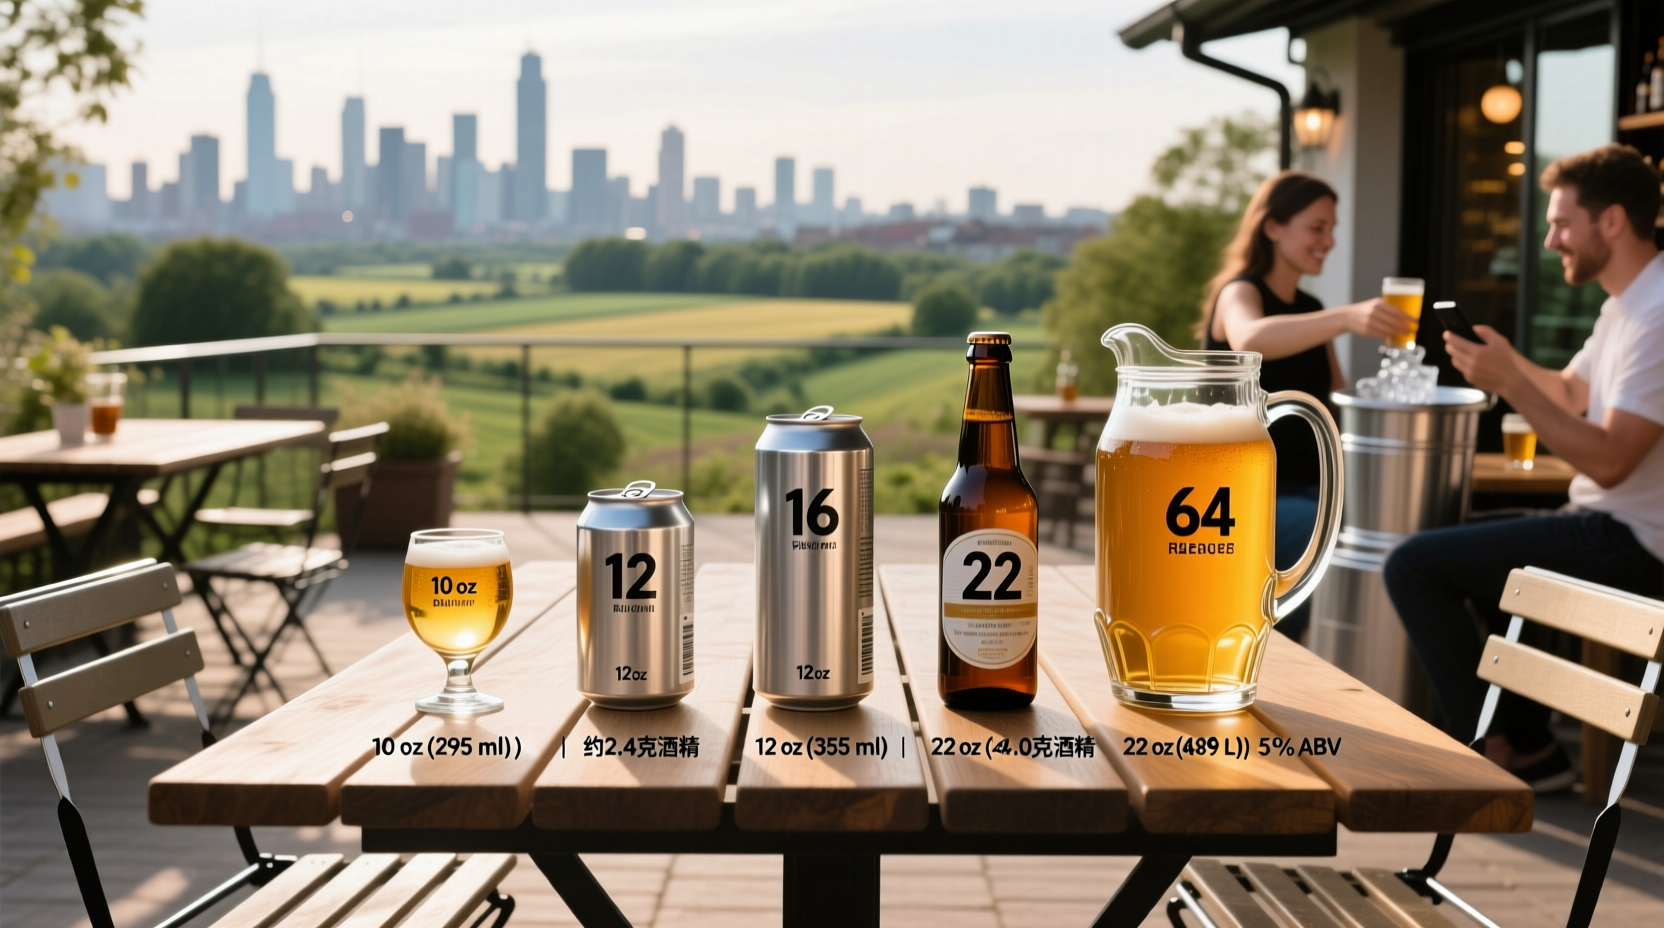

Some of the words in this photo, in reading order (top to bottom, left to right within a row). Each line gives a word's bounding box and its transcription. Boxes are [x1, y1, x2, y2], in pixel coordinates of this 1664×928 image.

[785, 488, 839, 536] 16
[1166, 487, 1235, 537] 64
[431, 576, 453, 594] 10
[456, 582, 477, 594] oz
[605, 552, 657, 600] 12
[962, 551, 1022, 600] 22
[615, 665, 648, 681] 12oz
[796, 664, 830, 680] 12oz
